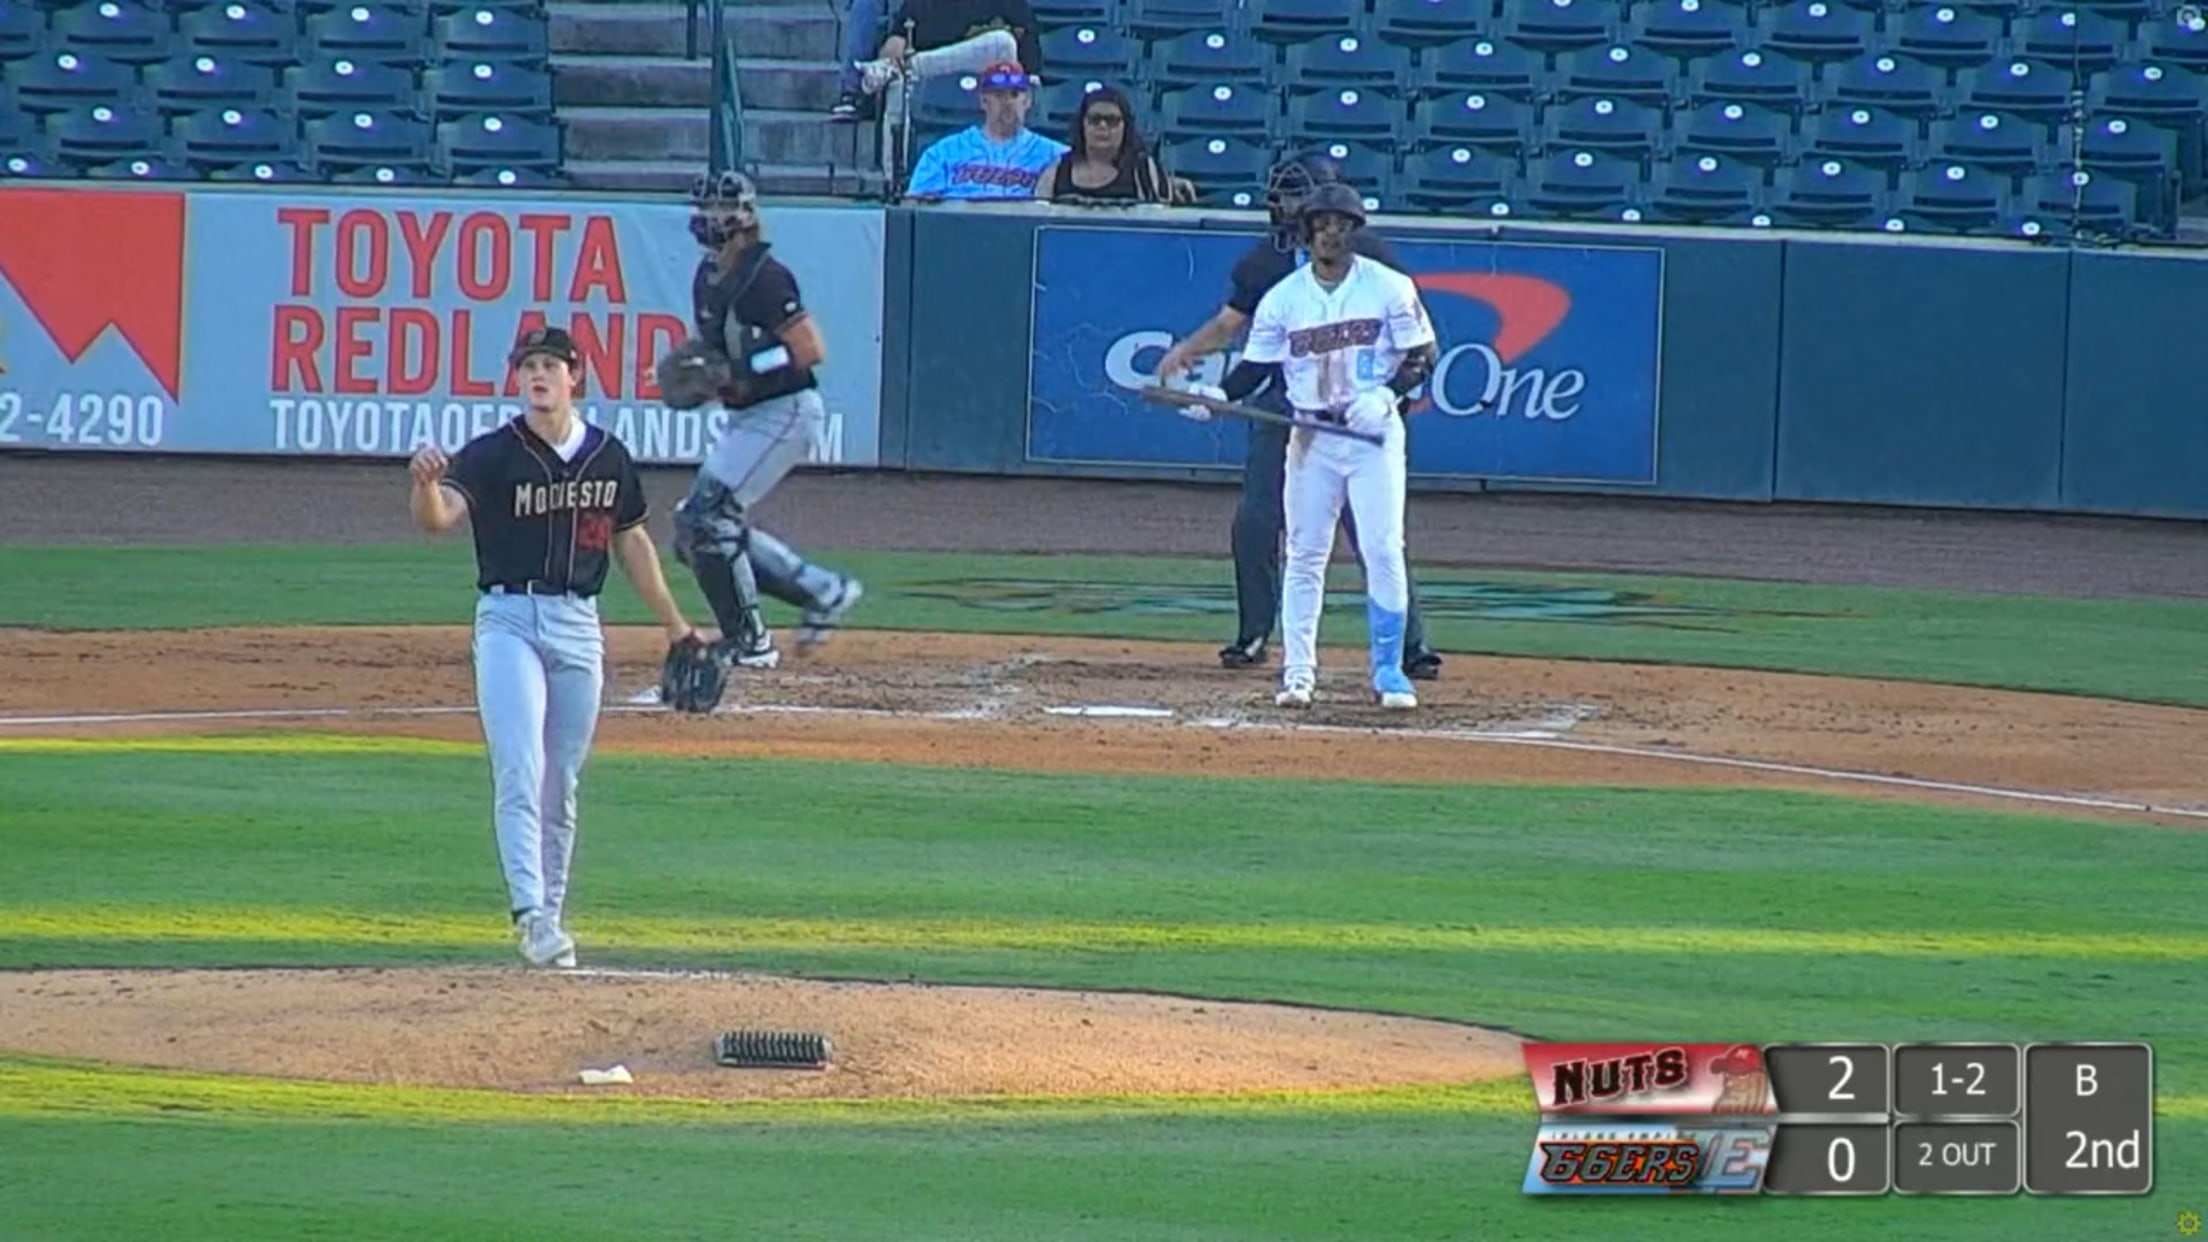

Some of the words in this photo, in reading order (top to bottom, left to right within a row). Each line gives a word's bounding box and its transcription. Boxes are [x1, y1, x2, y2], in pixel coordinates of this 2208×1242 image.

[277, 207, 627, 303] TOYOTA
[271, 304, 691, 400] REDLAND
[1431, 342, 1585, 420] One
[0, 392, 164, 446] 2-4290
